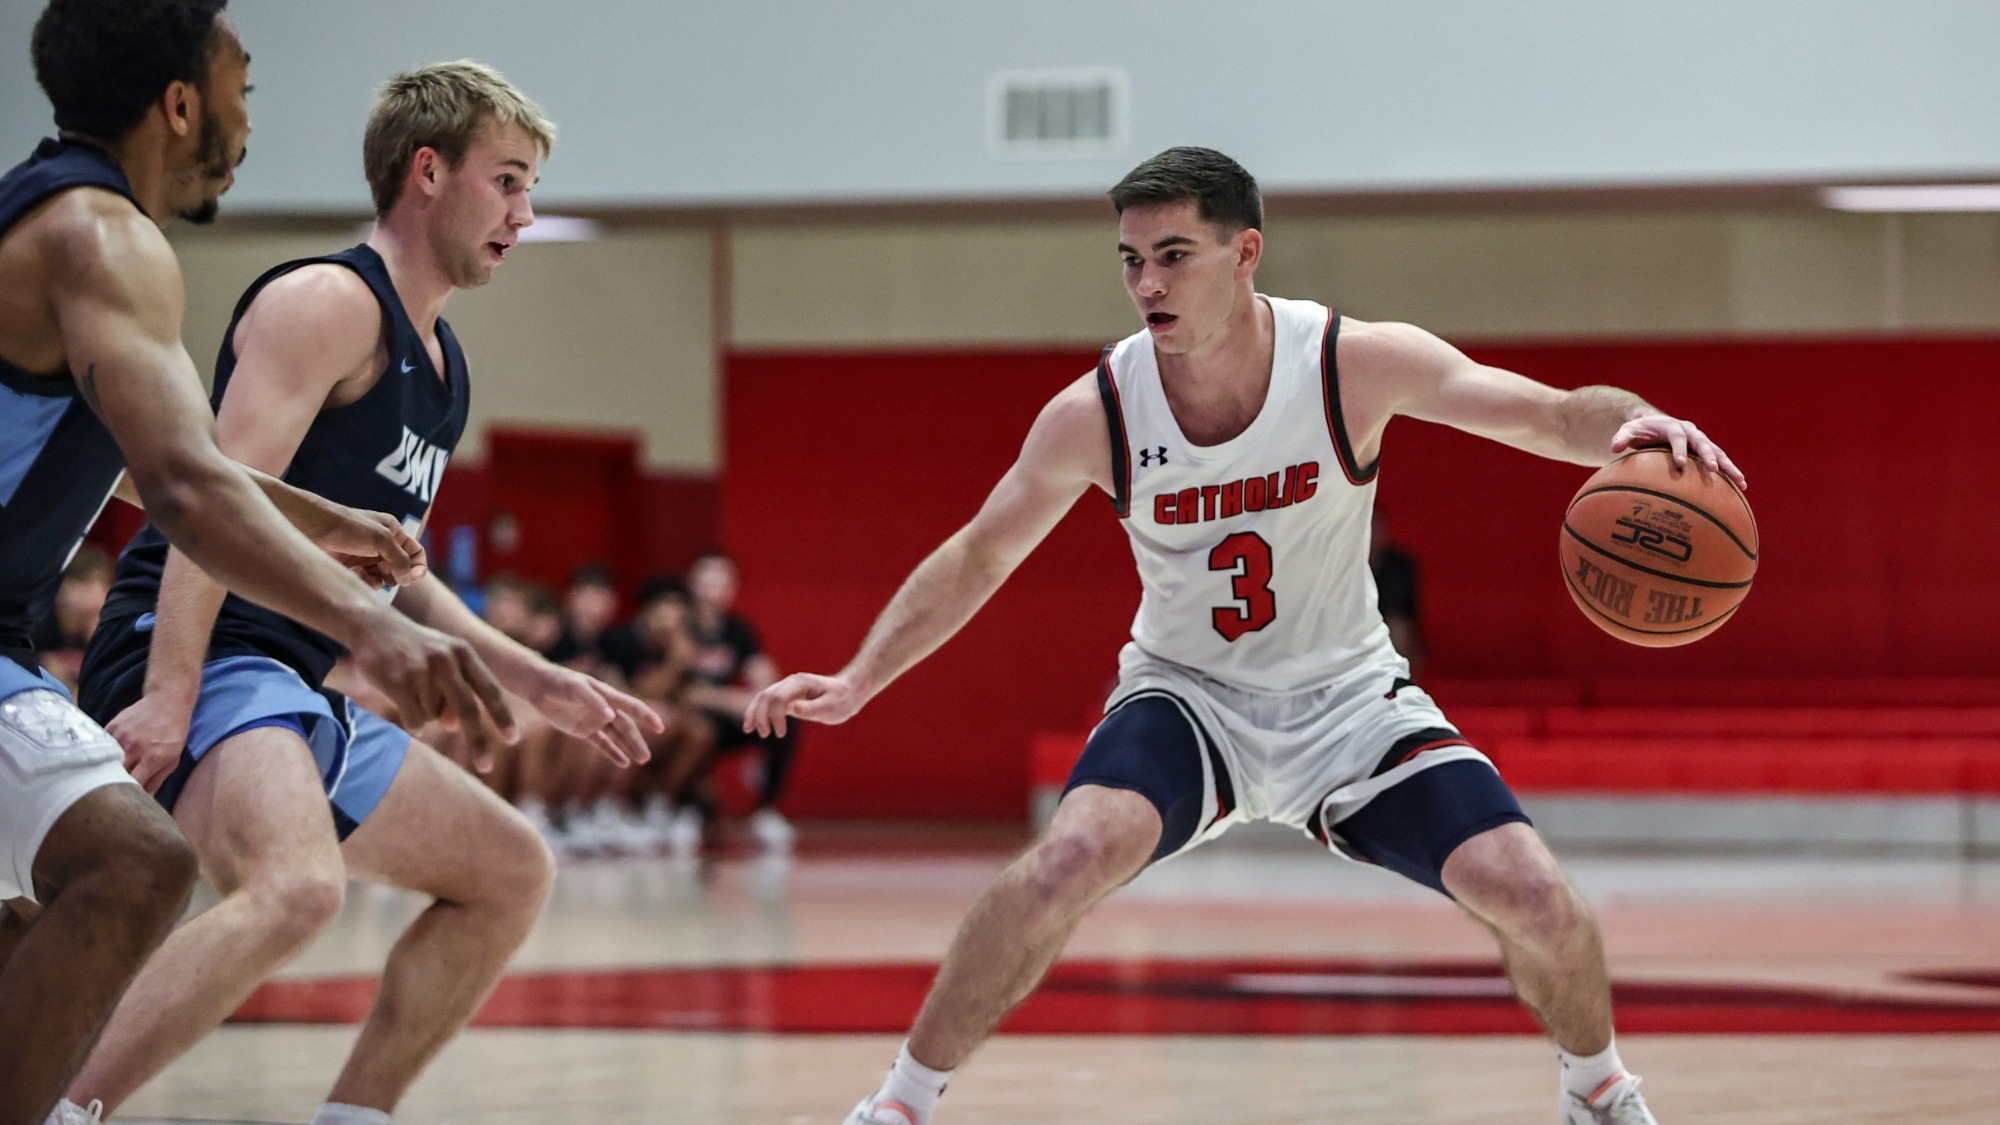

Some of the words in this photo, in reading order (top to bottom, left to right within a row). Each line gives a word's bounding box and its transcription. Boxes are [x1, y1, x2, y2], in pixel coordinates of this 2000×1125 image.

[1154, 461, 1319, 525] CATHOLIC
[1208, 531, 1276, 642] 3
[1576, 557, 1636, 618] ROCK
[1645, 590, 1702, 623] THE
